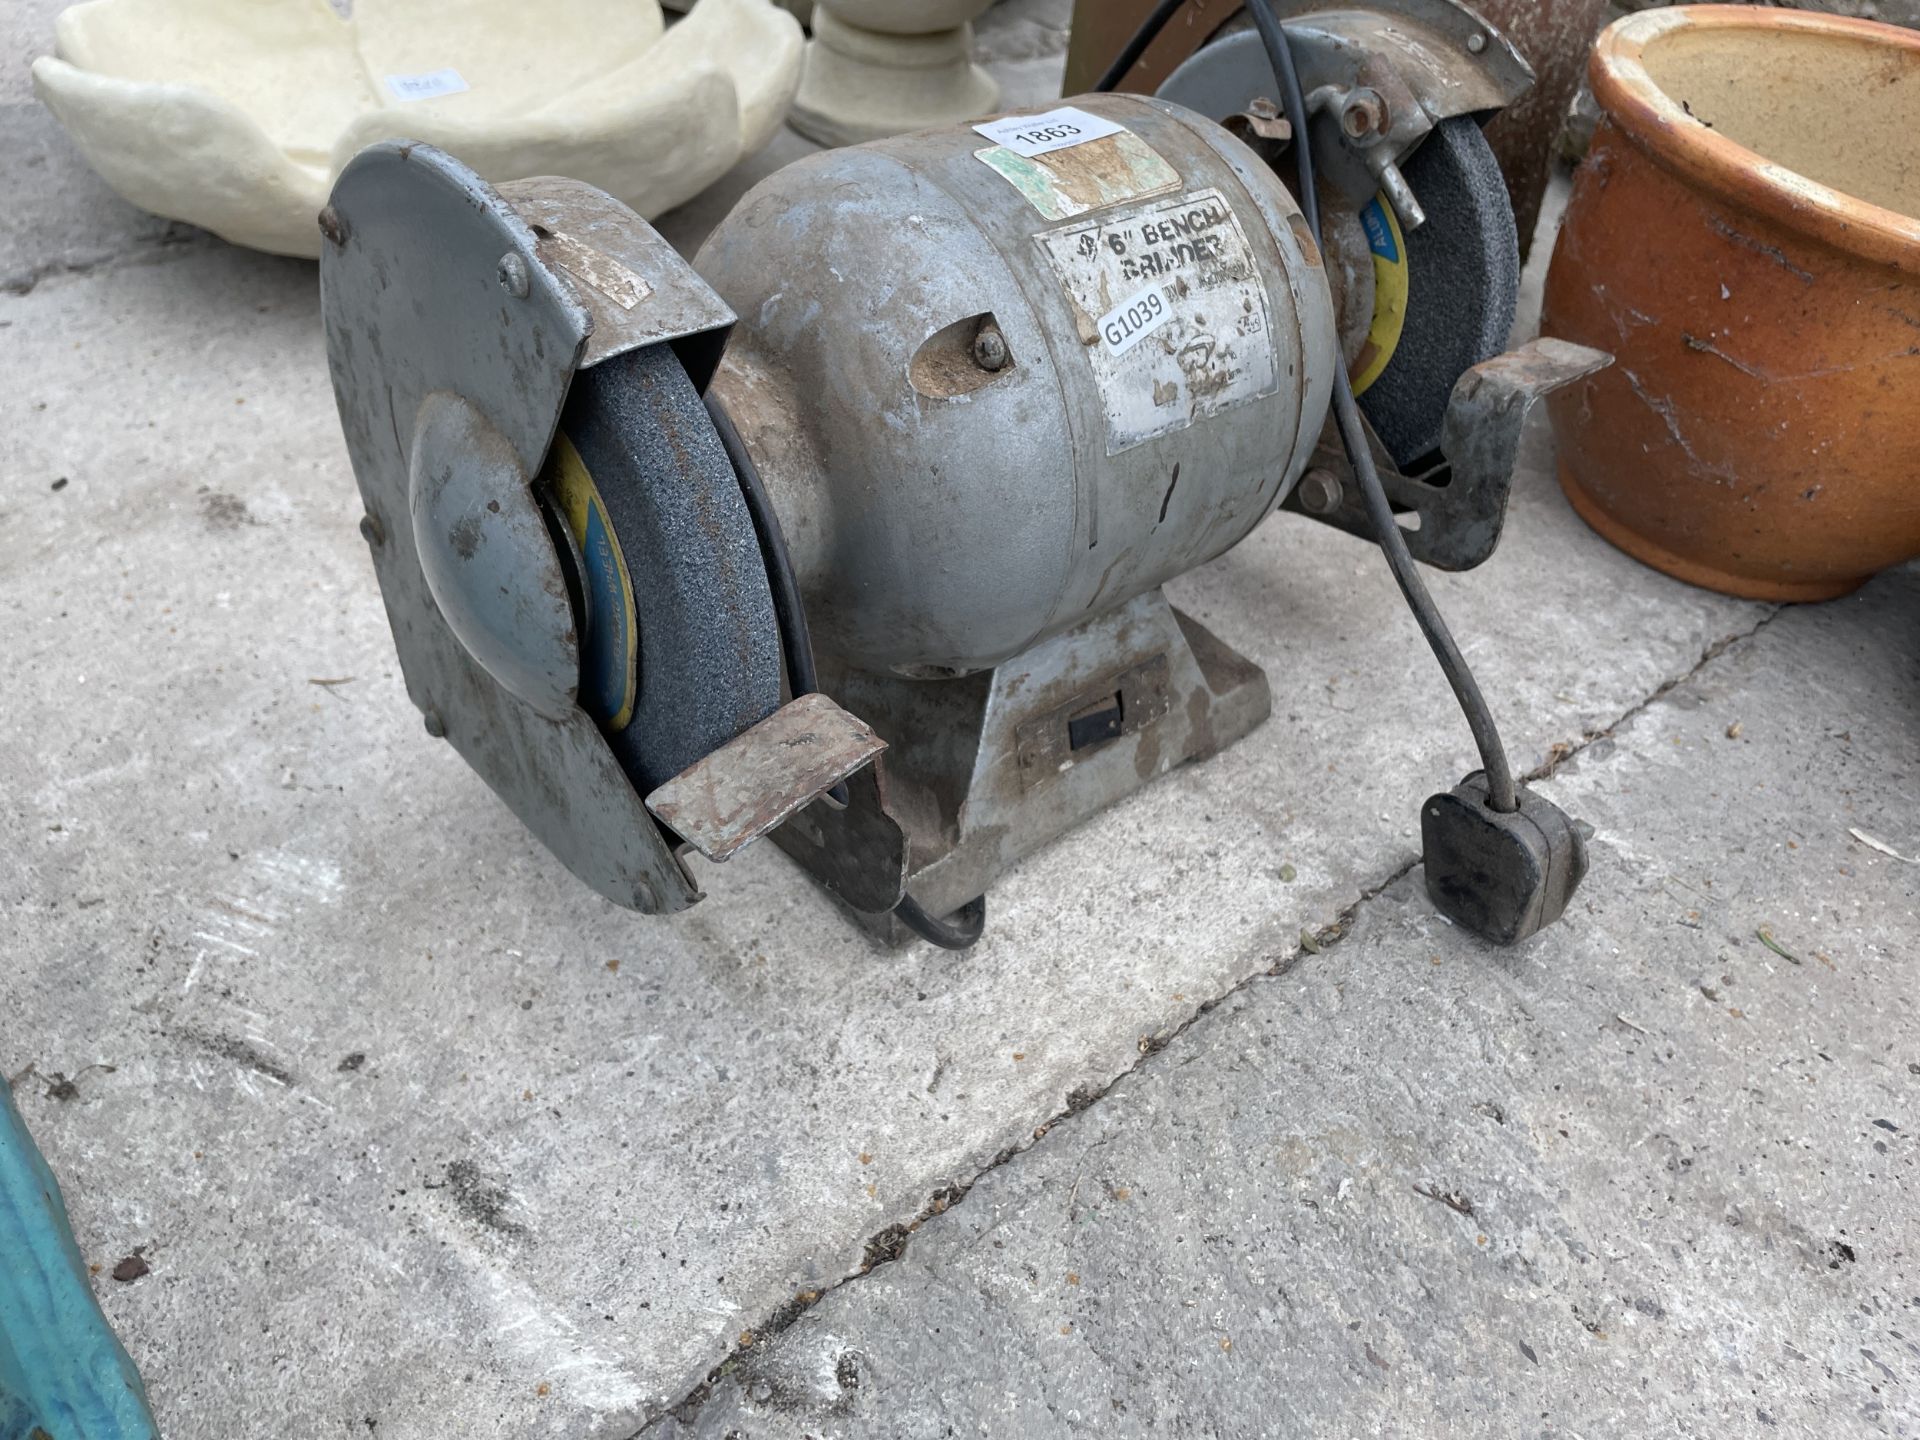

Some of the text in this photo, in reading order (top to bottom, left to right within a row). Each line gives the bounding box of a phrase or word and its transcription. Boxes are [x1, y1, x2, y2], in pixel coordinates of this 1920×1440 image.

[1016, 124, 1082, 145] 1863
[1142, 206, 1222, 246] BENCH
[1104, 293, 1163, 347] G1039
